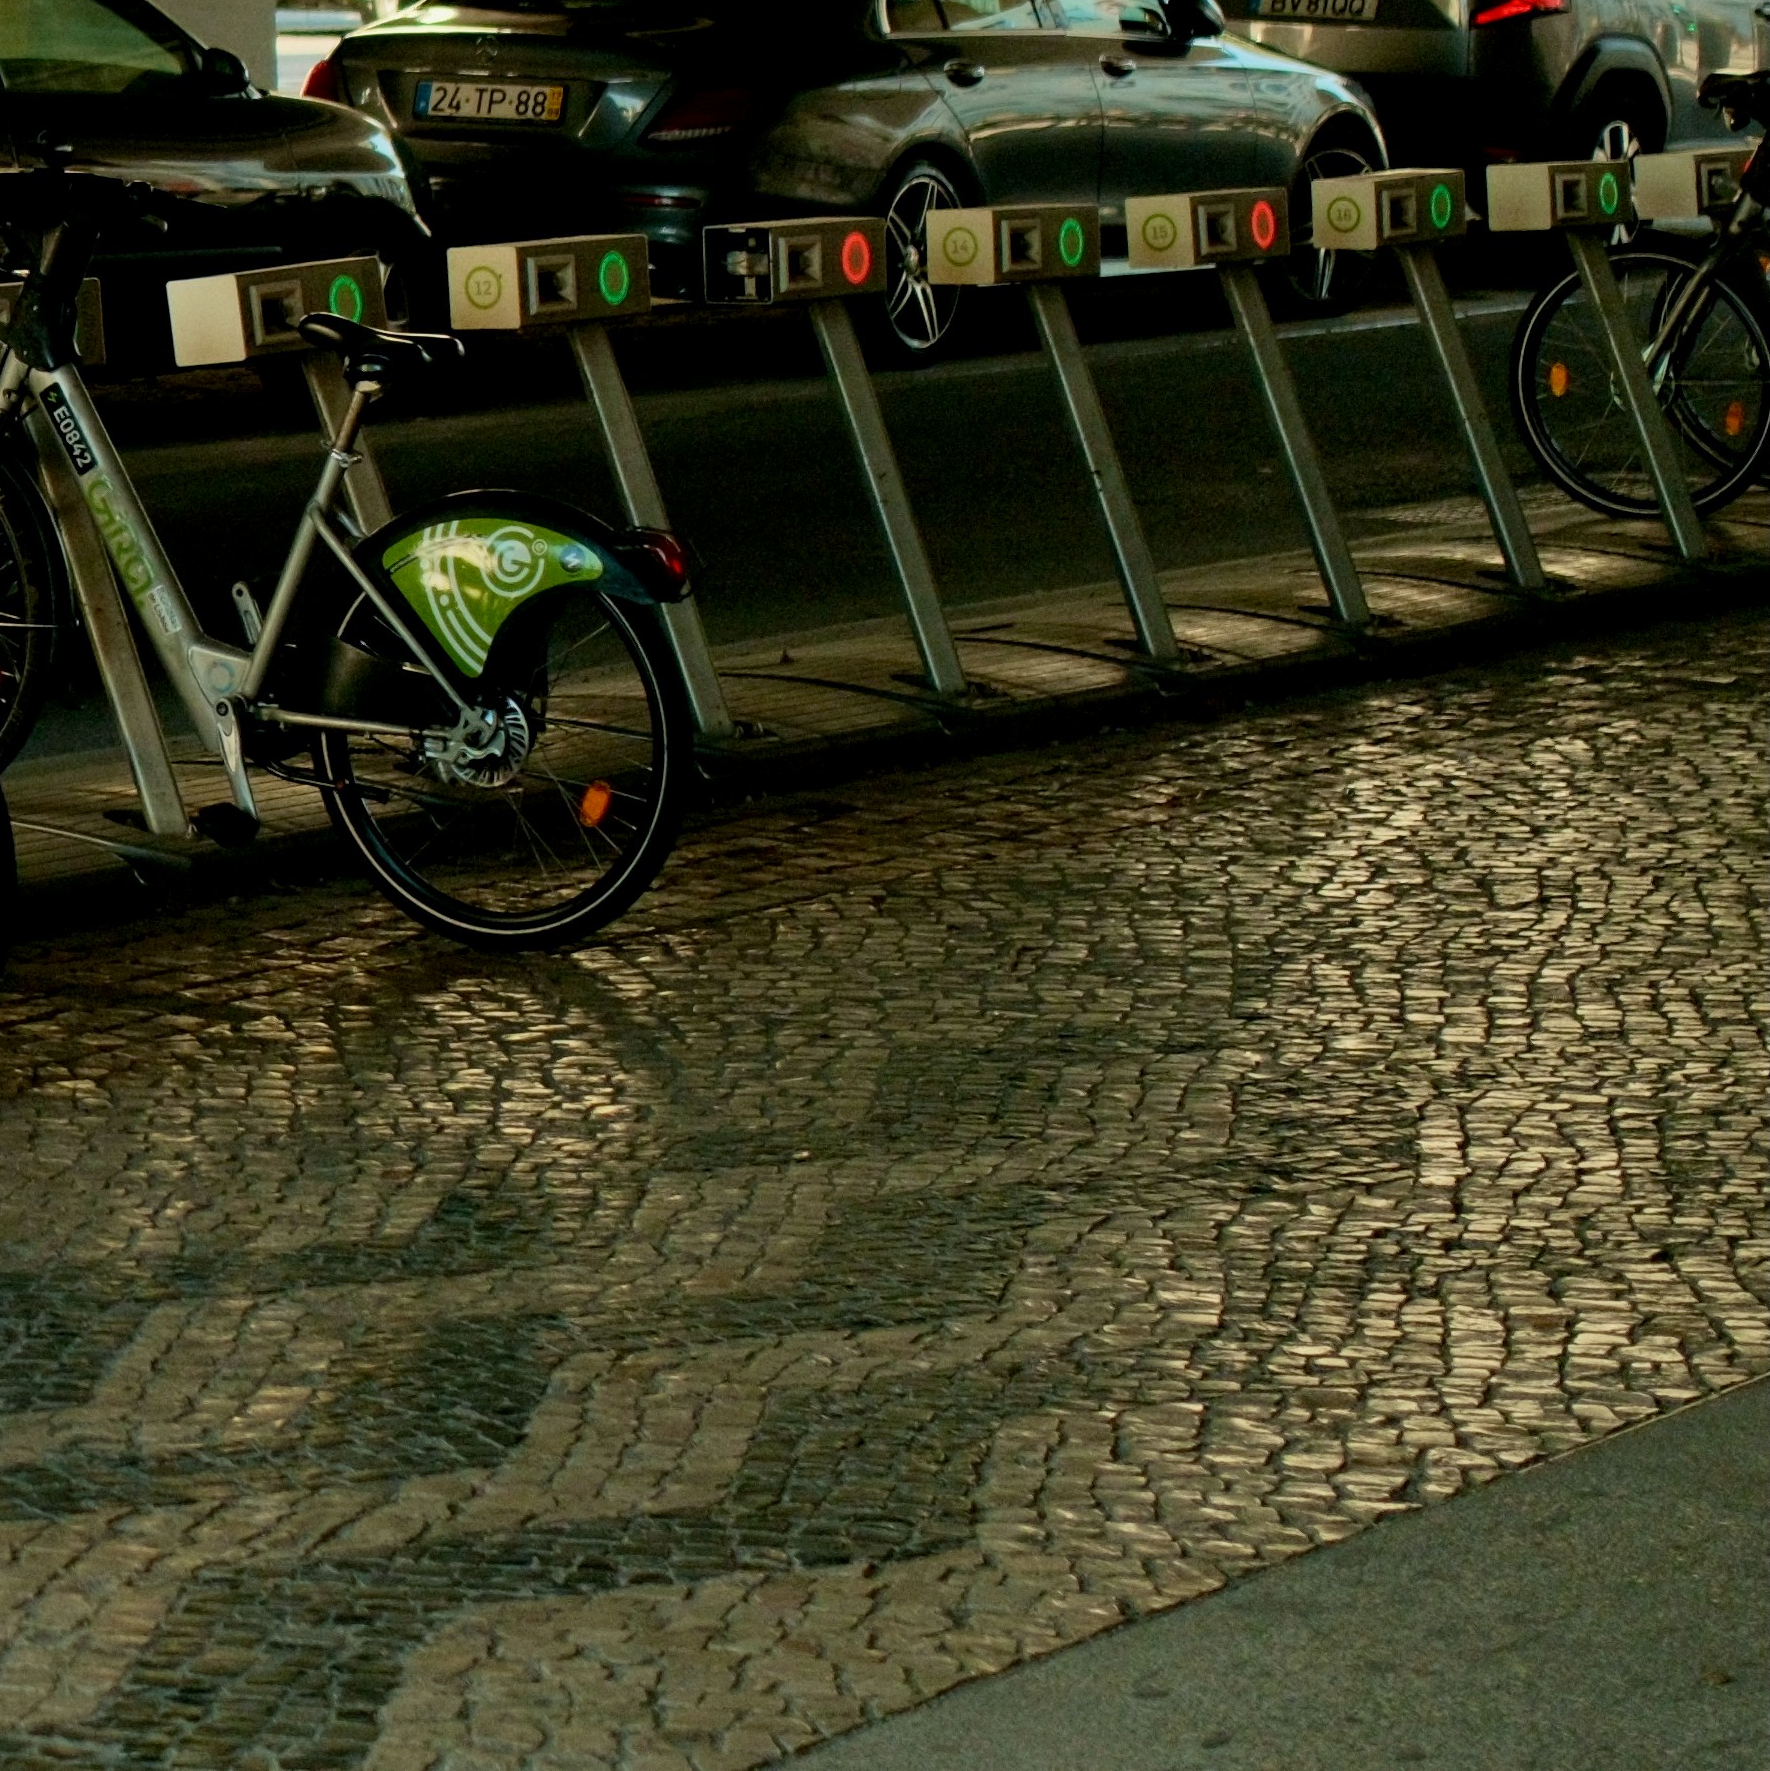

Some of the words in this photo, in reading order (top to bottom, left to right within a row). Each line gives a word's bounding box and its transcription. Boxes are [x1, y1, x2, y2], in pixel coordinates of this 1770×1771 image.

[1150, 225, 1168, 239] 15
[951, 239, 969, 254] 14
[474, 280, 492, 296] 12
[52, 405, 91, 468] E0842
